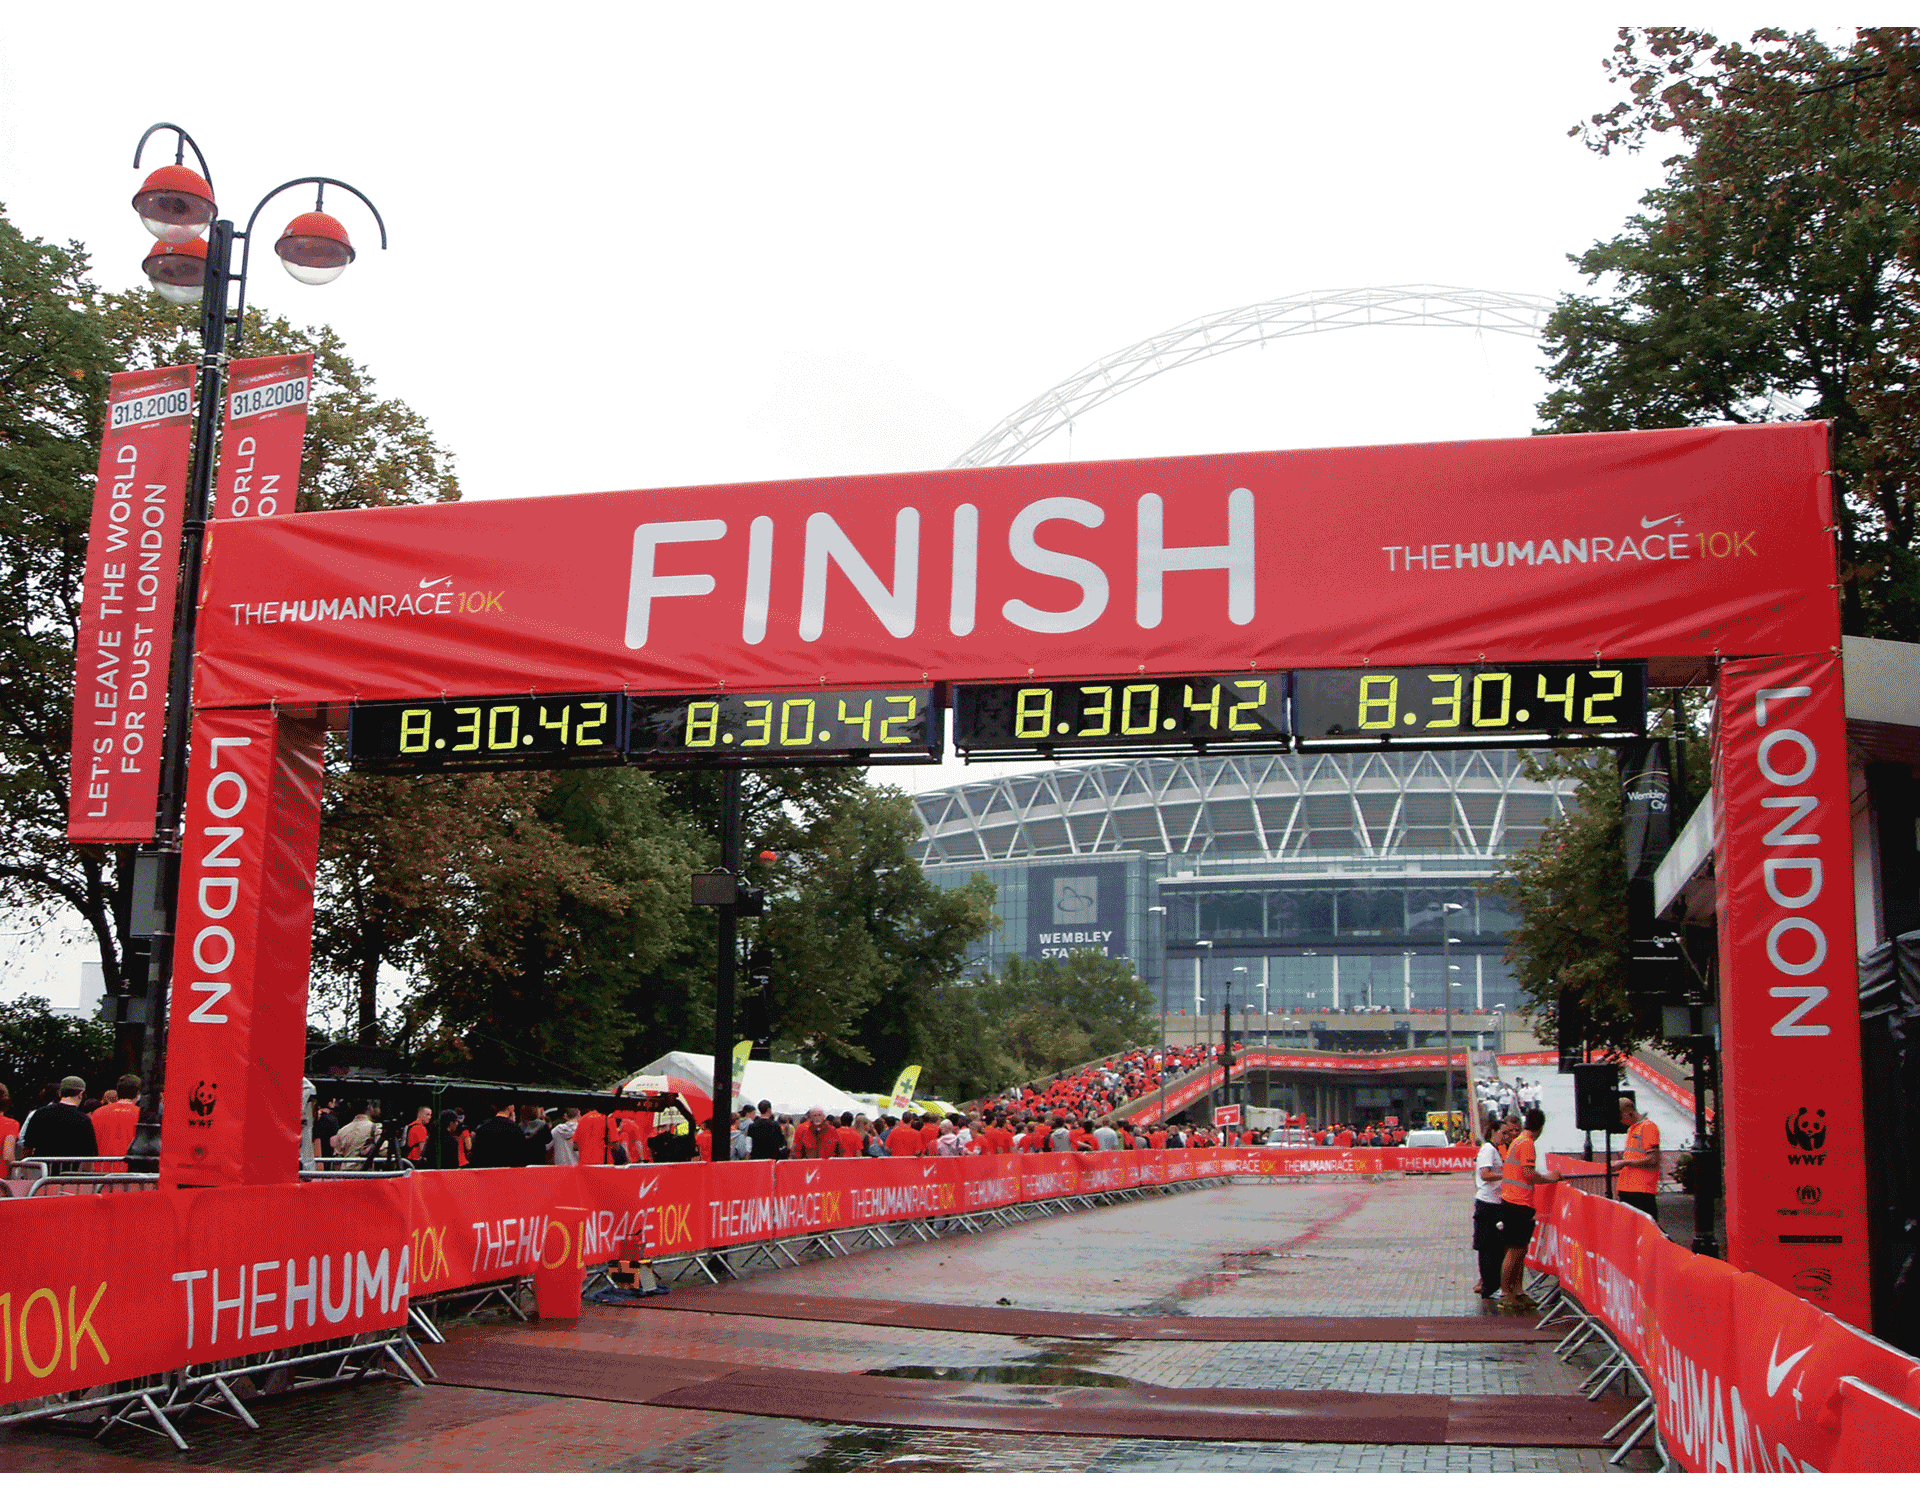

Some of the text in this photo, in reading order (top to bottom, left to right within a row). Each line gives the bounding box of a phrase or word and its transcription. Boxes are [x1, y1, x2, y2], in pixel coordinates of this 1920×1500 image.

[114, 392, 187, 425] 31.8.2008
[234, 381, 304, 415] 31.8.2008
[231, 437, 256, 517] ORLD
[624, 487, 1255, 649] FINISH
[87, 444, 137, 817] LET'S LEAVE THE WORLD
[121, 484, 167, 773] FOR DUST LONDON
[400, 702, 607, 753] 8.30.42
[686, 695, 917, 746] 8.30.42
[1015, 680, 1267, 738] 8.30.42
[1358, 670, 1623, 729] 8.30.42
[188, 737, 251, 1023] LONDON
[1756, 686, 1831, 1037] LONDON
[1039, 931, 1112, 944] WEMBLEY
[1041, 946, 1108, 959] STAM
[1787, 1153, 1827, 1166] WWF
[411, 1226, 450, 1284] 10K
[0, 1281, 110, 1383] 10K
